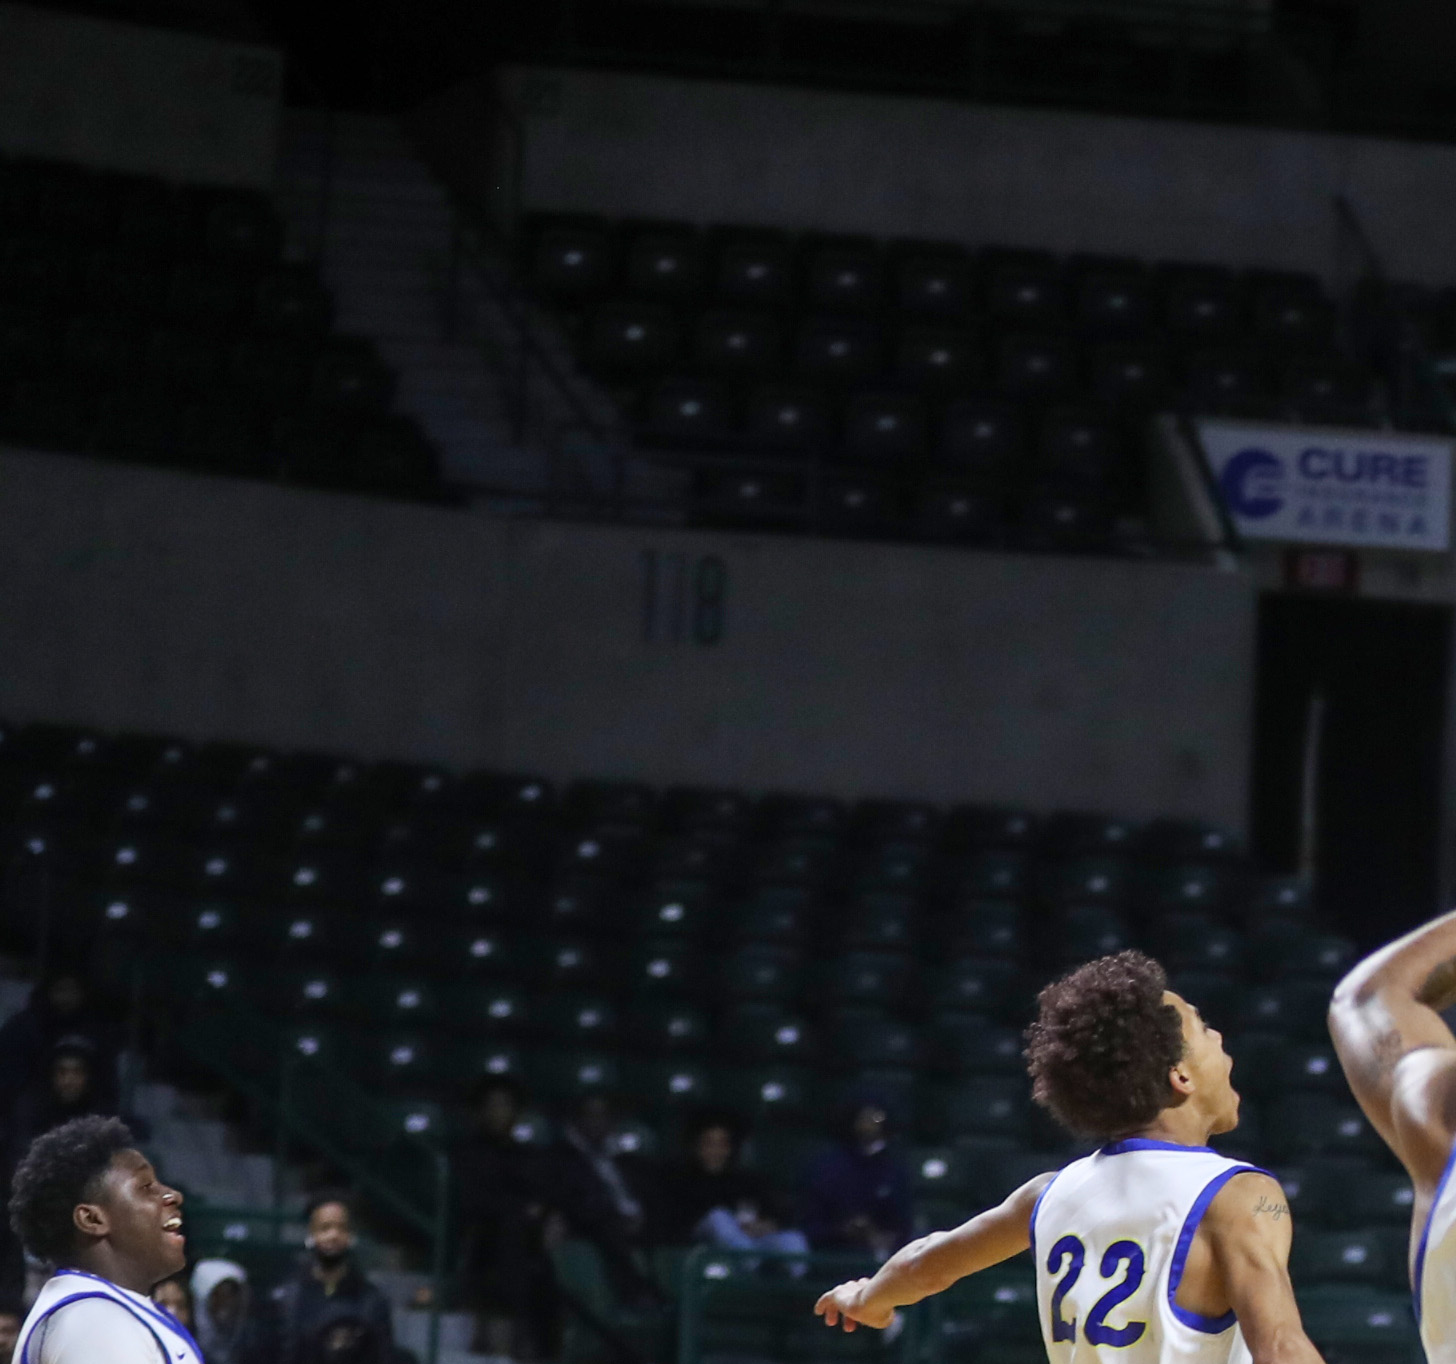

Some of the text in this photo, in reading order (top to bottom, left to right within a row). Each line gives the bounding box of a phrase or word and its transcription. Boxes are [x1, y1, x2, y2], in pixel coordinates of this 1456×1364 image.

[1298, 448, 1430, 489] CURE
[641, 549, 728, 647] 118
[1045, 1232, 1150, 1349] 22
